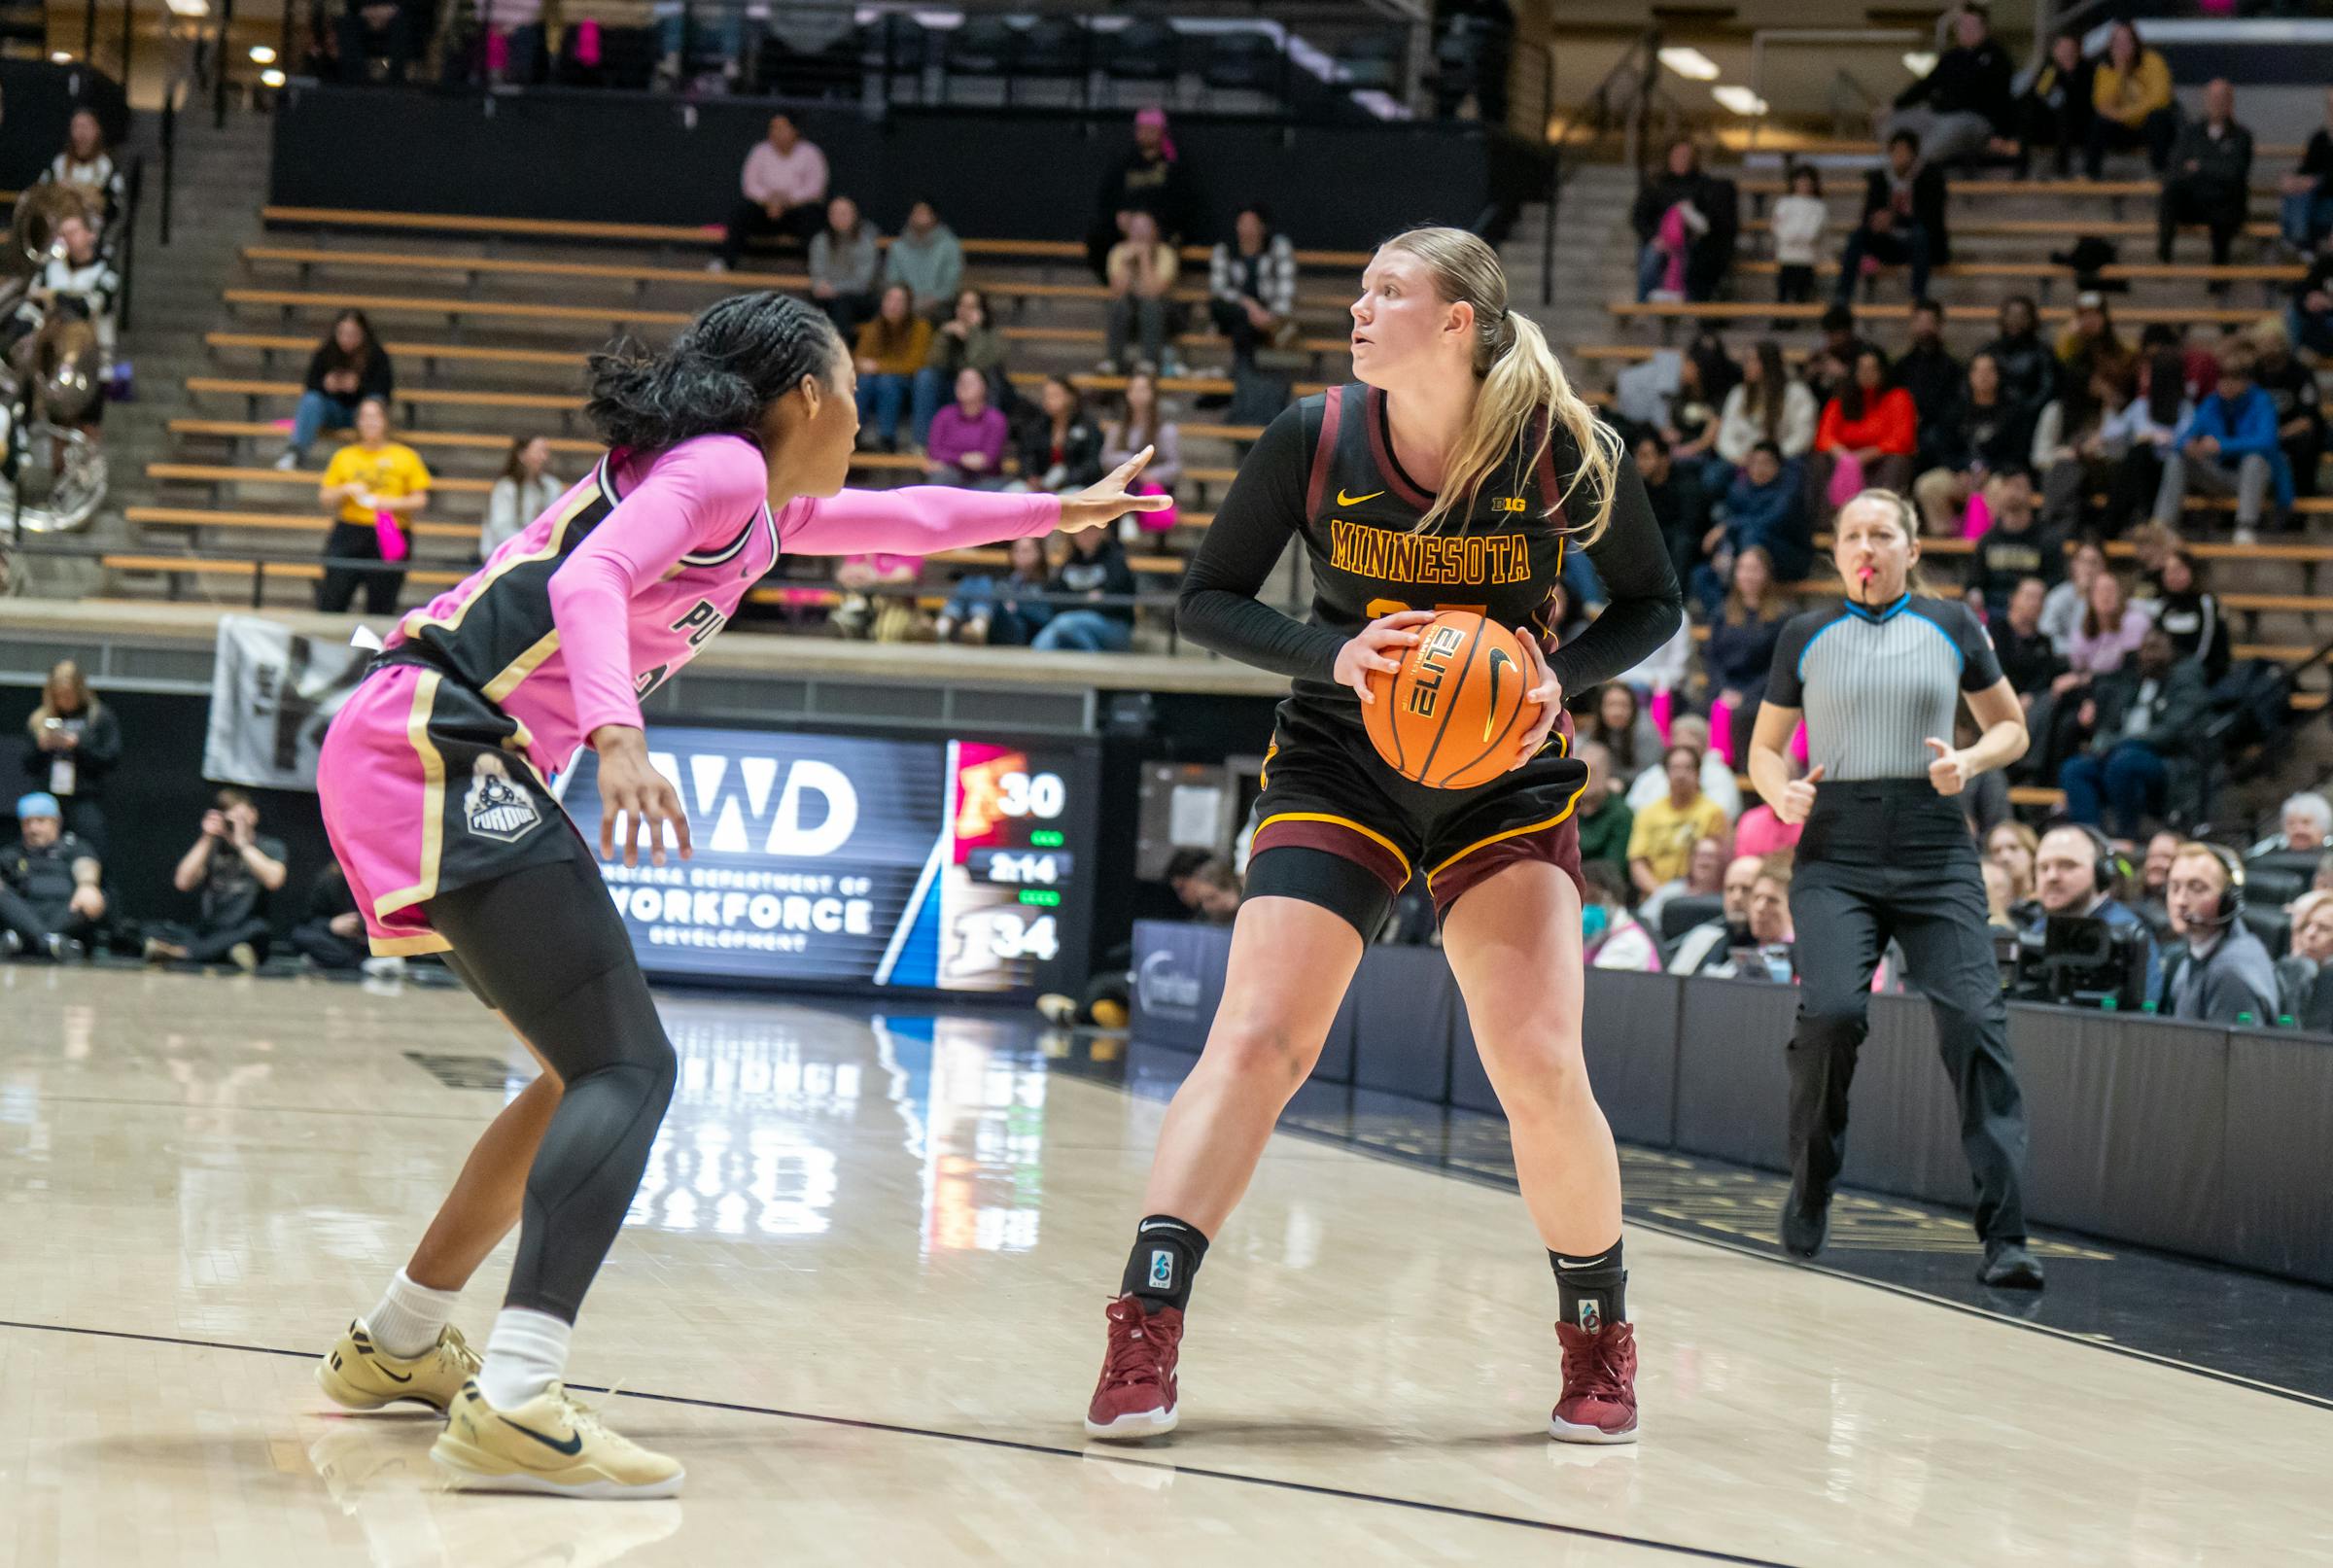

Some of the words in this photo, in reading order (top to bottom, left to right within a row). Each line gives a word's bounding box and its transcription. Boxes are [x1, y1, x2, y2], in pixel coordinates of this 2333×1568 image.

[1330, 519, 1531, 585] MINNESOTA
[669, 597, 727, 650] PU
[1408, 625, 1466, 719] ELITE
[472, 805, 537, 832] PURDUE
[997, 772, 1065, 819] 30
[601, 863, 684, 886] NDIANA
[690, 867, 833, 894] DEPARTMENT
[839, 877, 872, 896] OF
[648, 924, 807, 953] DEVELOPMENT
[990, 914, 1060, 960] 34
